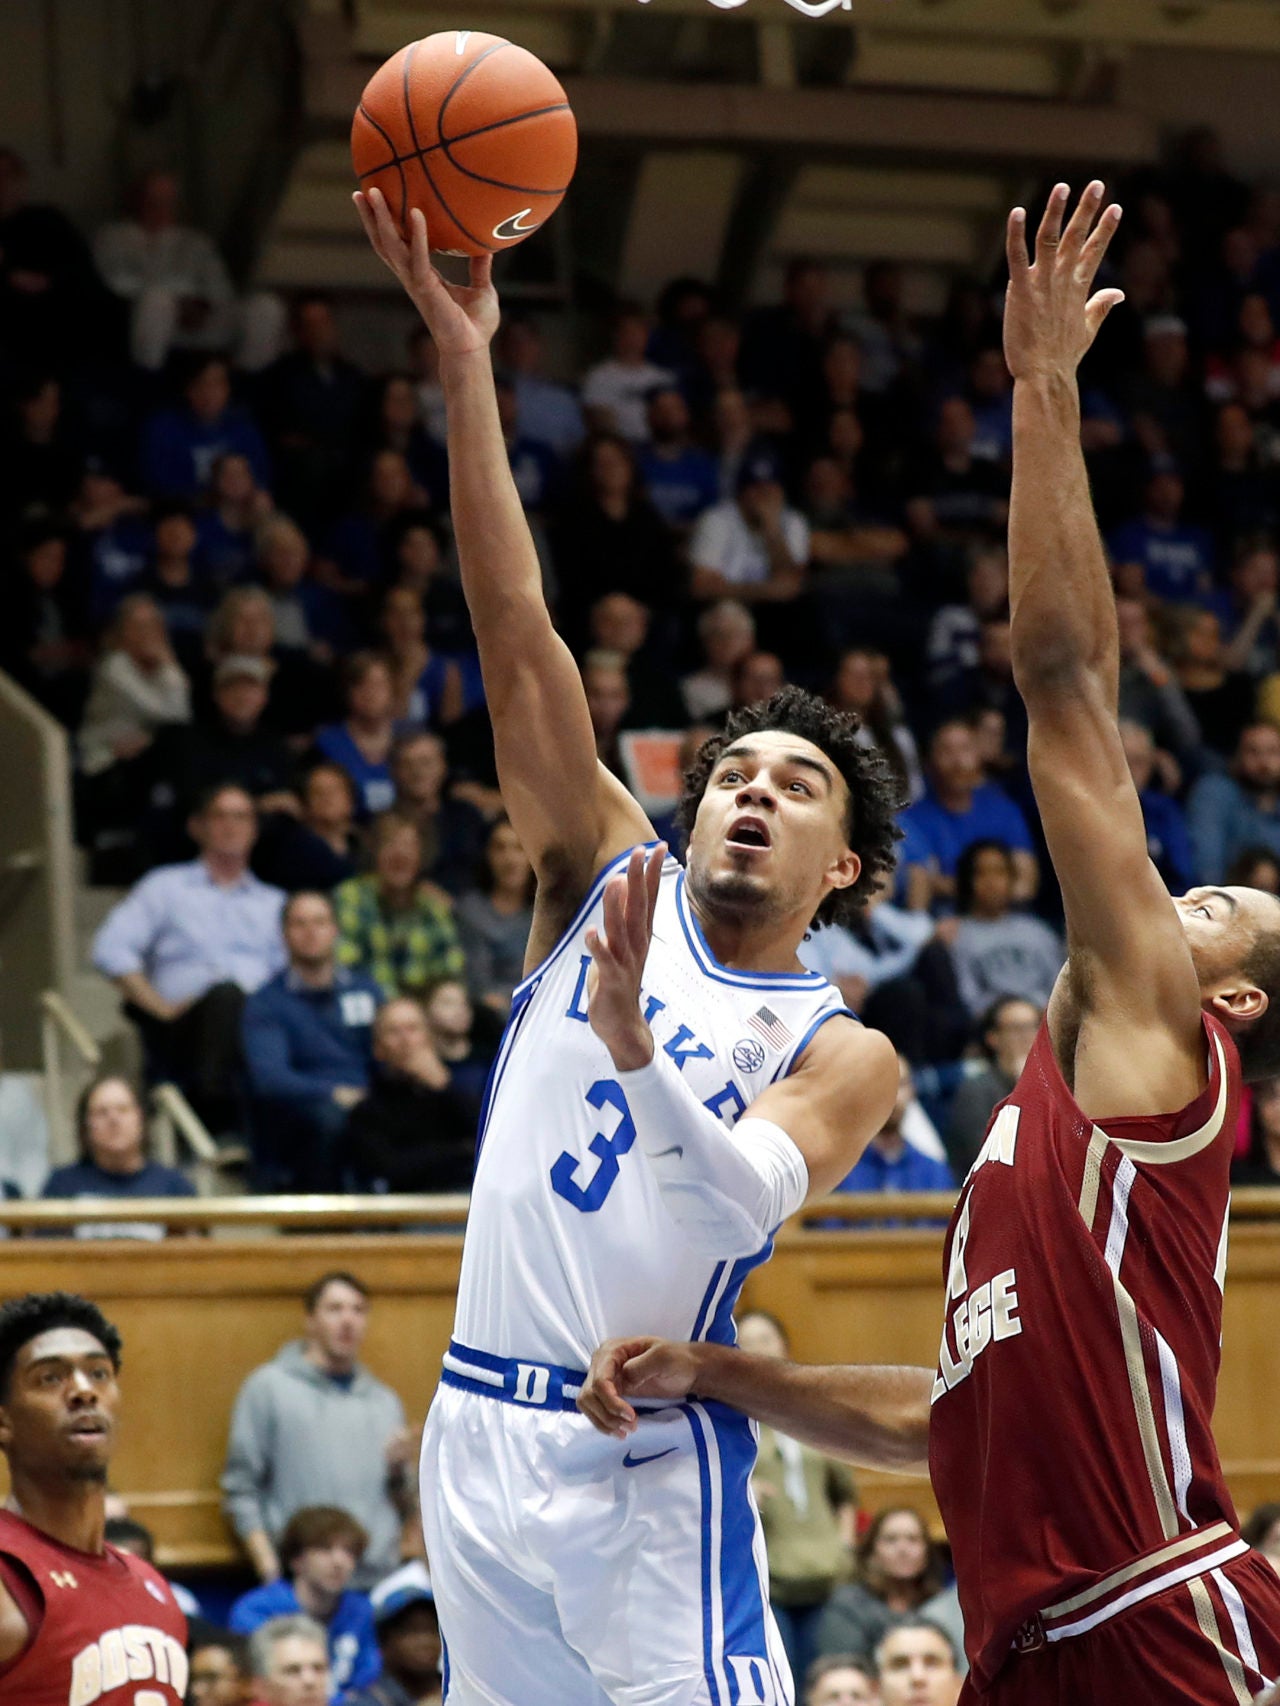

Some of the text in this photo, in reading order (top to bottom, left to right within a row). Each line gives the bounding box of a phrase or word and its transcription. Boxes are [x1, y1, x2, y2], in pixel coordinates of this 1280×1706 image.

[566, 955, 747, 1123] KE
[550, 1079, 637, 1213] 3
[513, 1363, 550, 1404] D
